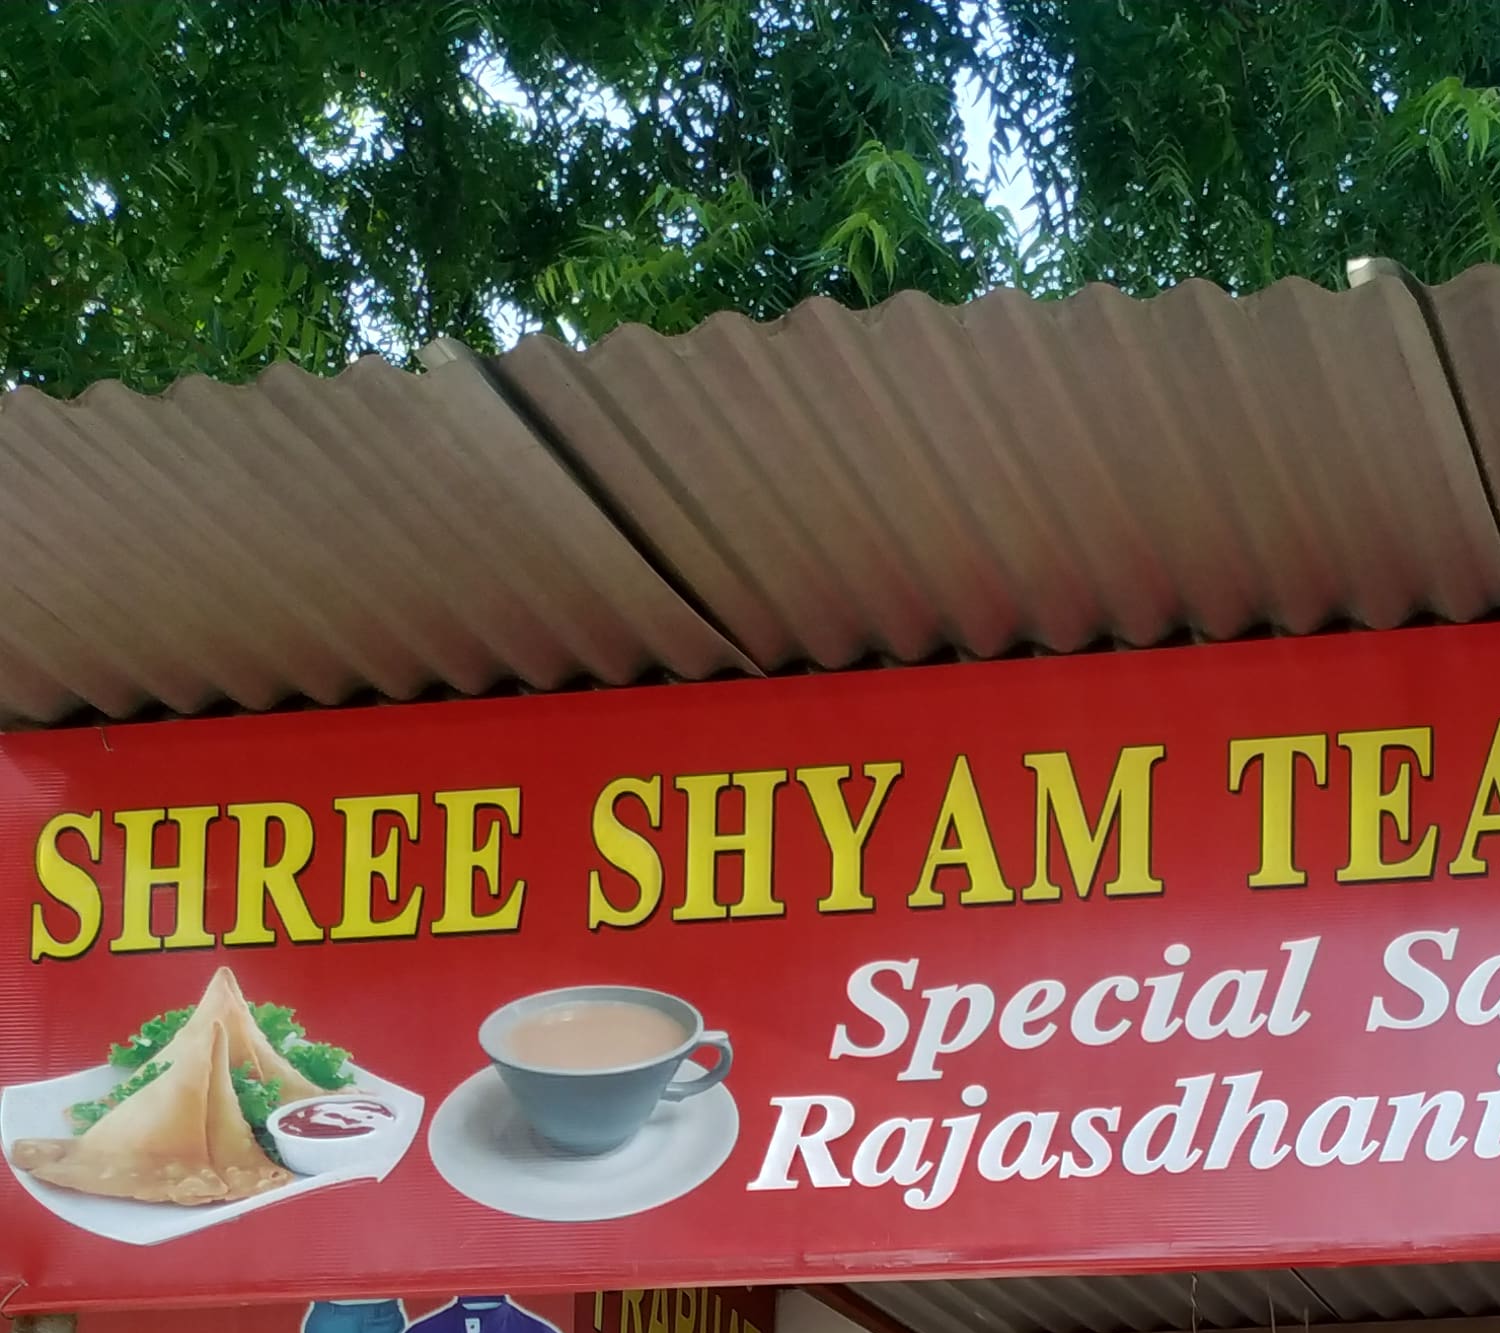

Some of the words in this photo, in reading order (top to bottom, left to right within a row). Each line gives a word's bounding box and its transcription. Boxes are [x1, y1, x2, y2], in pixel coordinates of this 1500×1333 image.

[28, 785, 526, 962] SHREE
[587, 744, 1169, 931] SHYAM
[829, 934, 1322, 1084] Special
